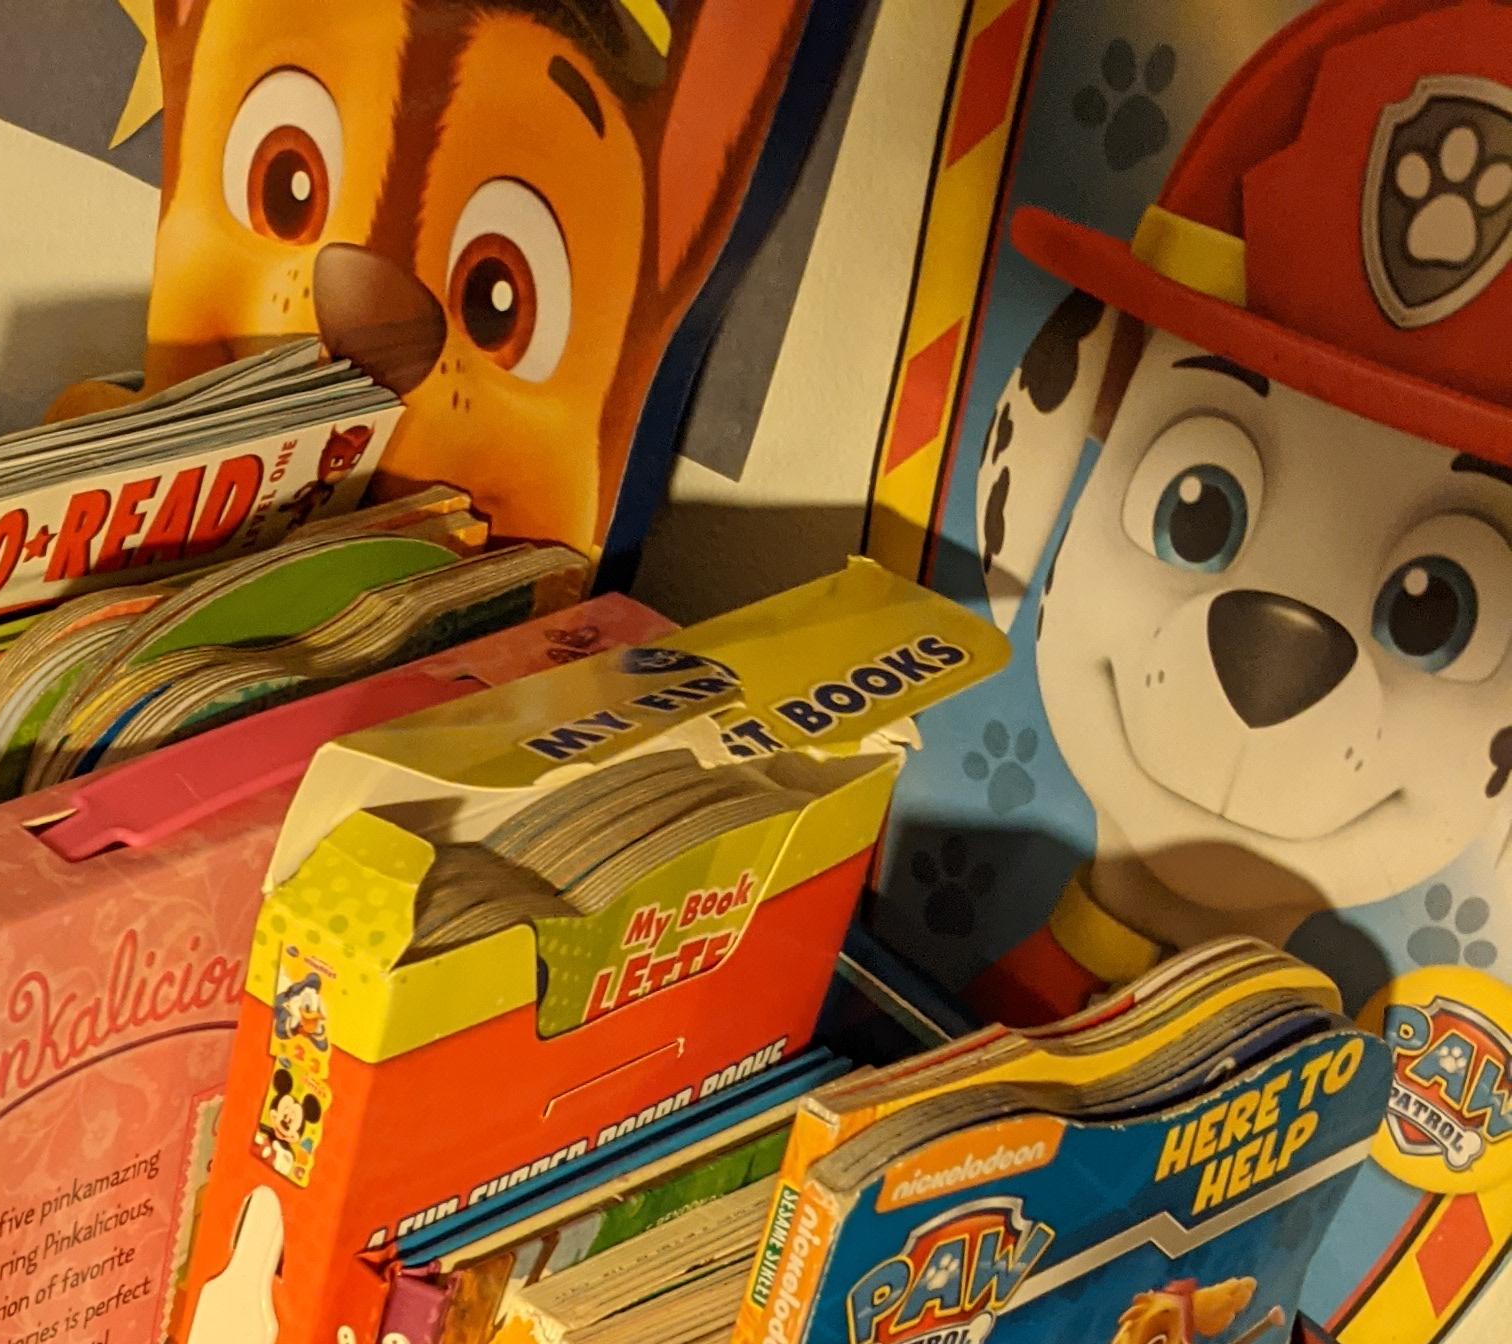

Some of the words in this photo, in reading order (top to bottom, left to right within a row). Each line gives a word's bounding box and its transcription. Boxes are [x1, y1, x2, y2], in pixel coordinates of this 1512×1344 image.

[44, 453, 265, 582] READ
[241, 481, 278, 551] LEVEL
[269, 438, 299, 480] ONE
[520, 708, 638, 765] MY
[772, 634, 972, 736] BOOKS
[624, 906, 672, 950] My
[678, 872, 756, 929] Book
[1154, 1078, 1288, 1183] HERE
[1296, 1036, 1368, 1115] TO
[39, 1150, 162, 1223] pinkamazing
[891, 1137, 1049, 1201] nickelodeon
[1192, 1111, 1320, 1214] HELP
[42, 1196, 155, 1262] Pinkalicious,
[766, 1189, 800, 1256] SESAME
[35, 1275, 62, 1310] of
[63, 1244, 136, 1292] favorite
[63, 1309, 80, 1332] is
[84, 1274, 154, 1331] perfect
